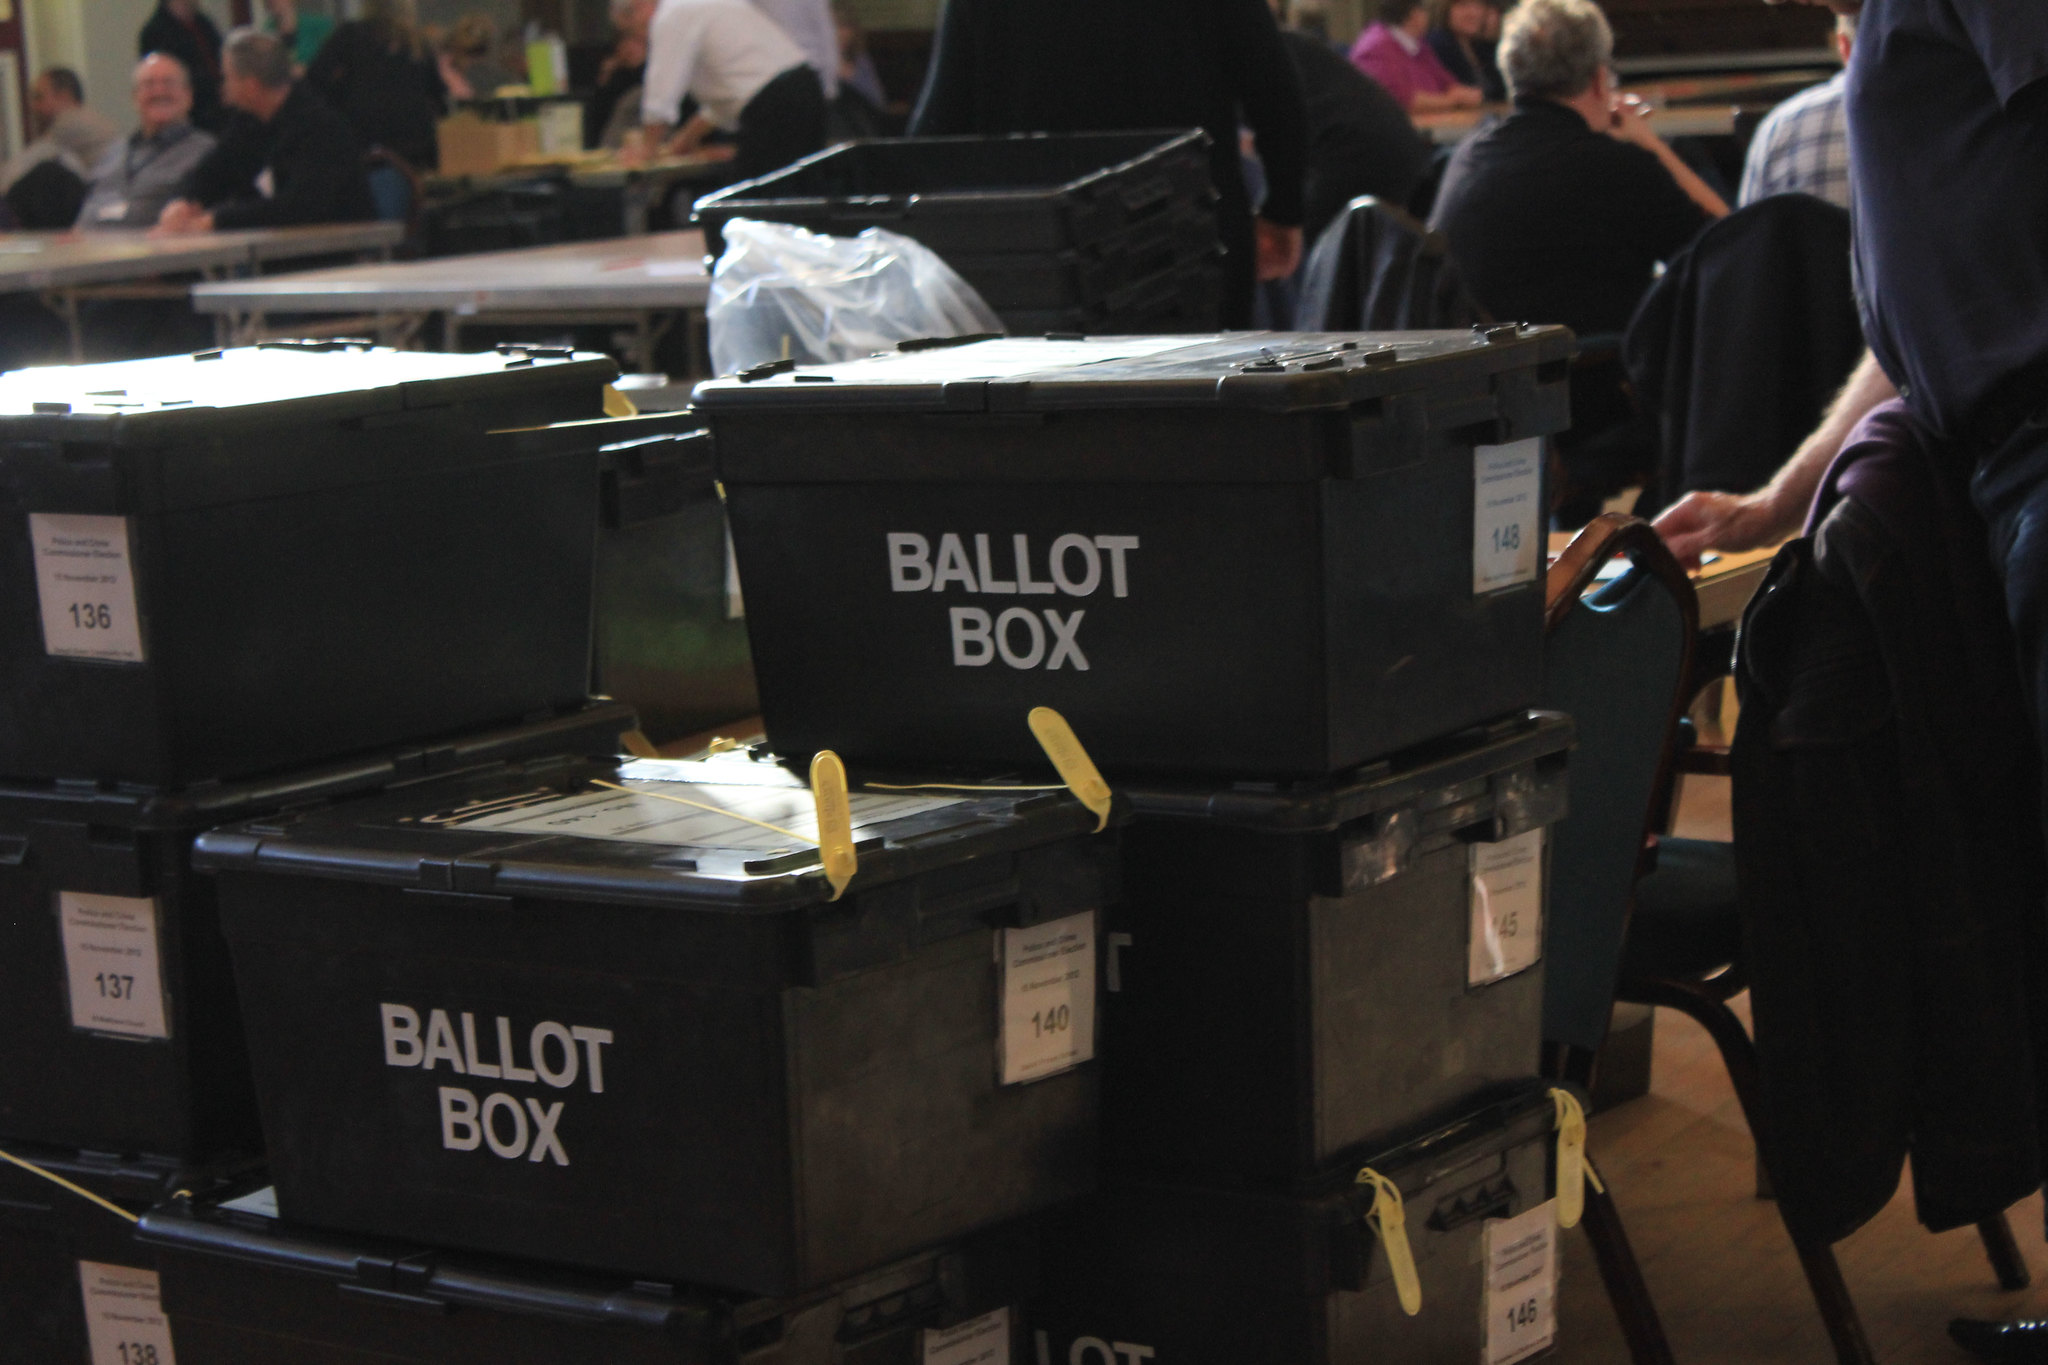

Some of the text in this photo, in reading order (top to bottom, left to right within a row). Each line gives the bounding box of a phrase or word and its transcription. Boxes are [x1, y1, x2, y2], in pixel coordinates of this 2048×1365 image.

[1492, 523, 1520, 552] 148
[887, 532, 1139, 597] BALLOT
[69, 603, 111, 629] 136
[949, 607, 1090, 671] BOX
[95, 972, 134, 1000] 137
[1031, 1003, 1070, 1038] 140
[380, 1002, 614, 1093] BALLOT
[438, 1086, 570, 1166] BOX
[1507, 1297, 1537, 1333] 146
[118, 1341, 159, 1365] 138
